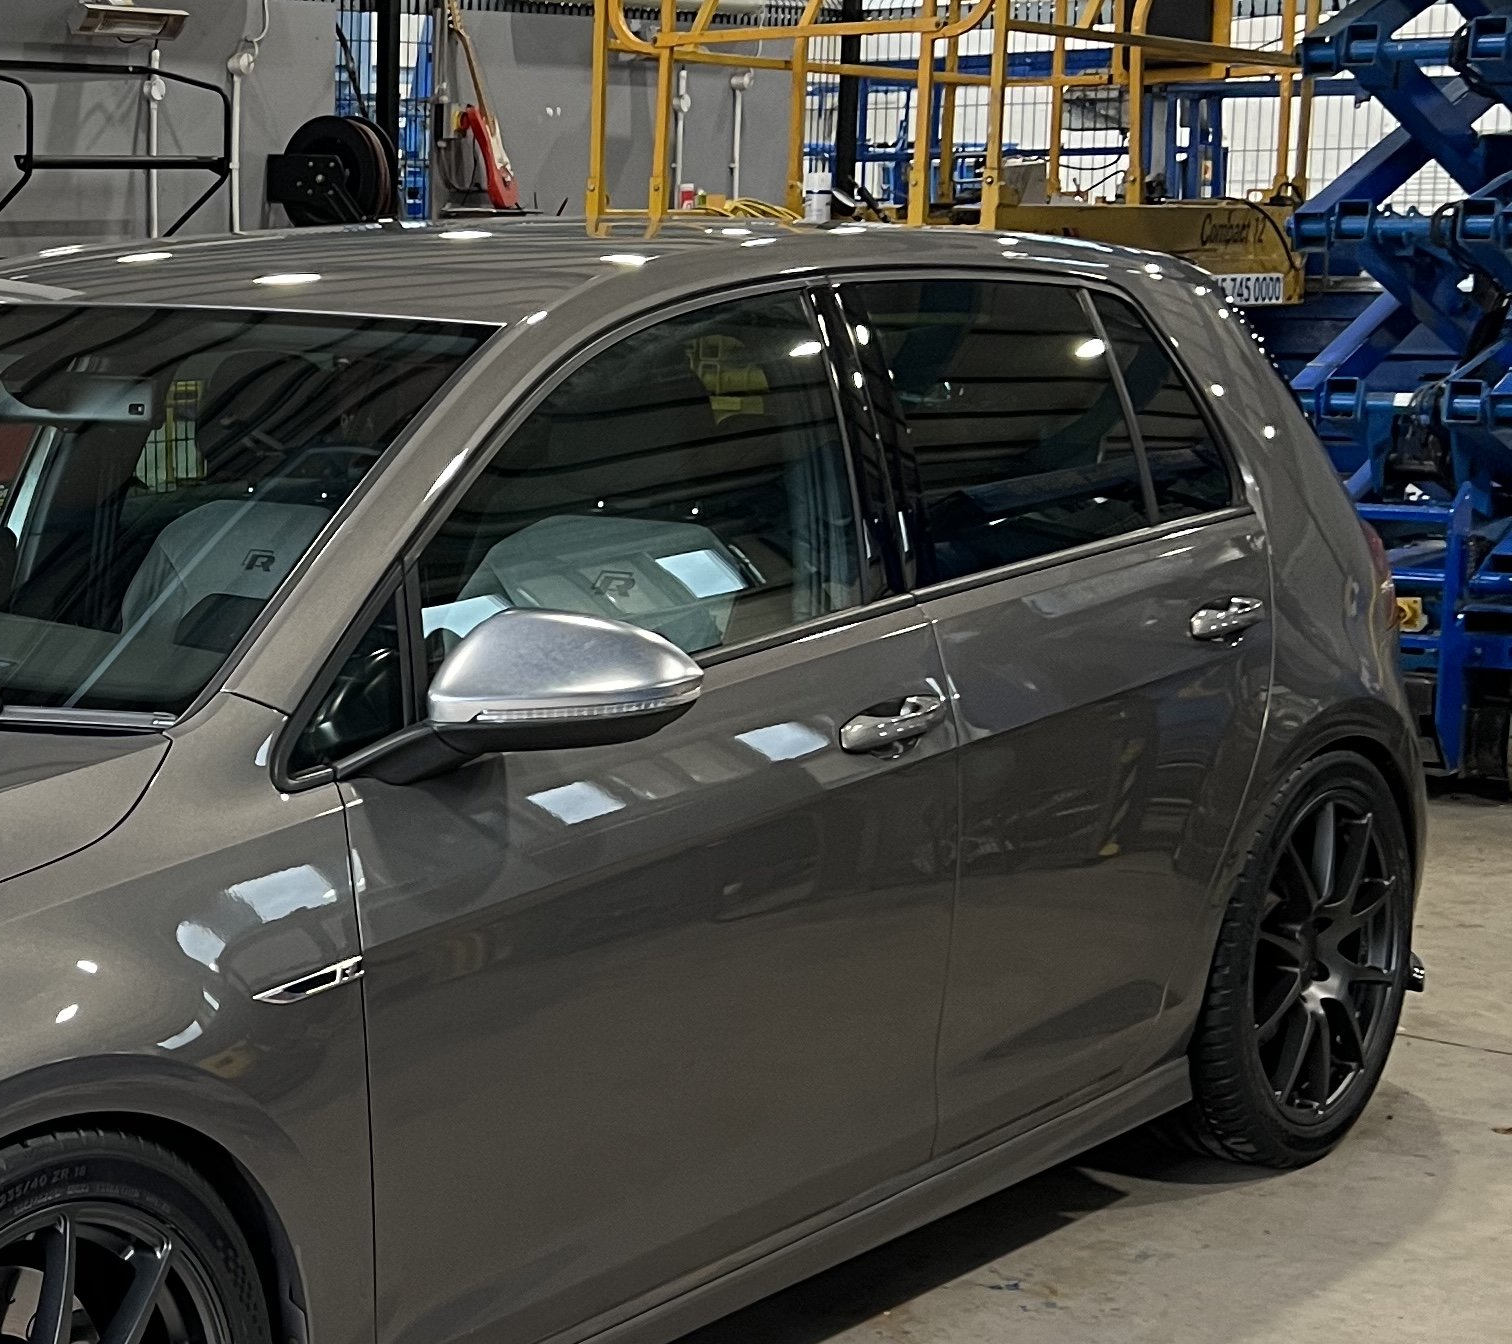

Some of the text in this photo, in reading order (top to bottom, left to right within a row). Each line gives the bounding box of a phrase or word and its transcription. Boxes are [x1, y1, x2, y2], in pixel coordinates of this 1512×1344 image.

[1230, 276, 1251, 303] 745
[1253, 276, 1281, 302] 0000
[241, 549, 275, 572] R
[591, 570, 635, 597] R
